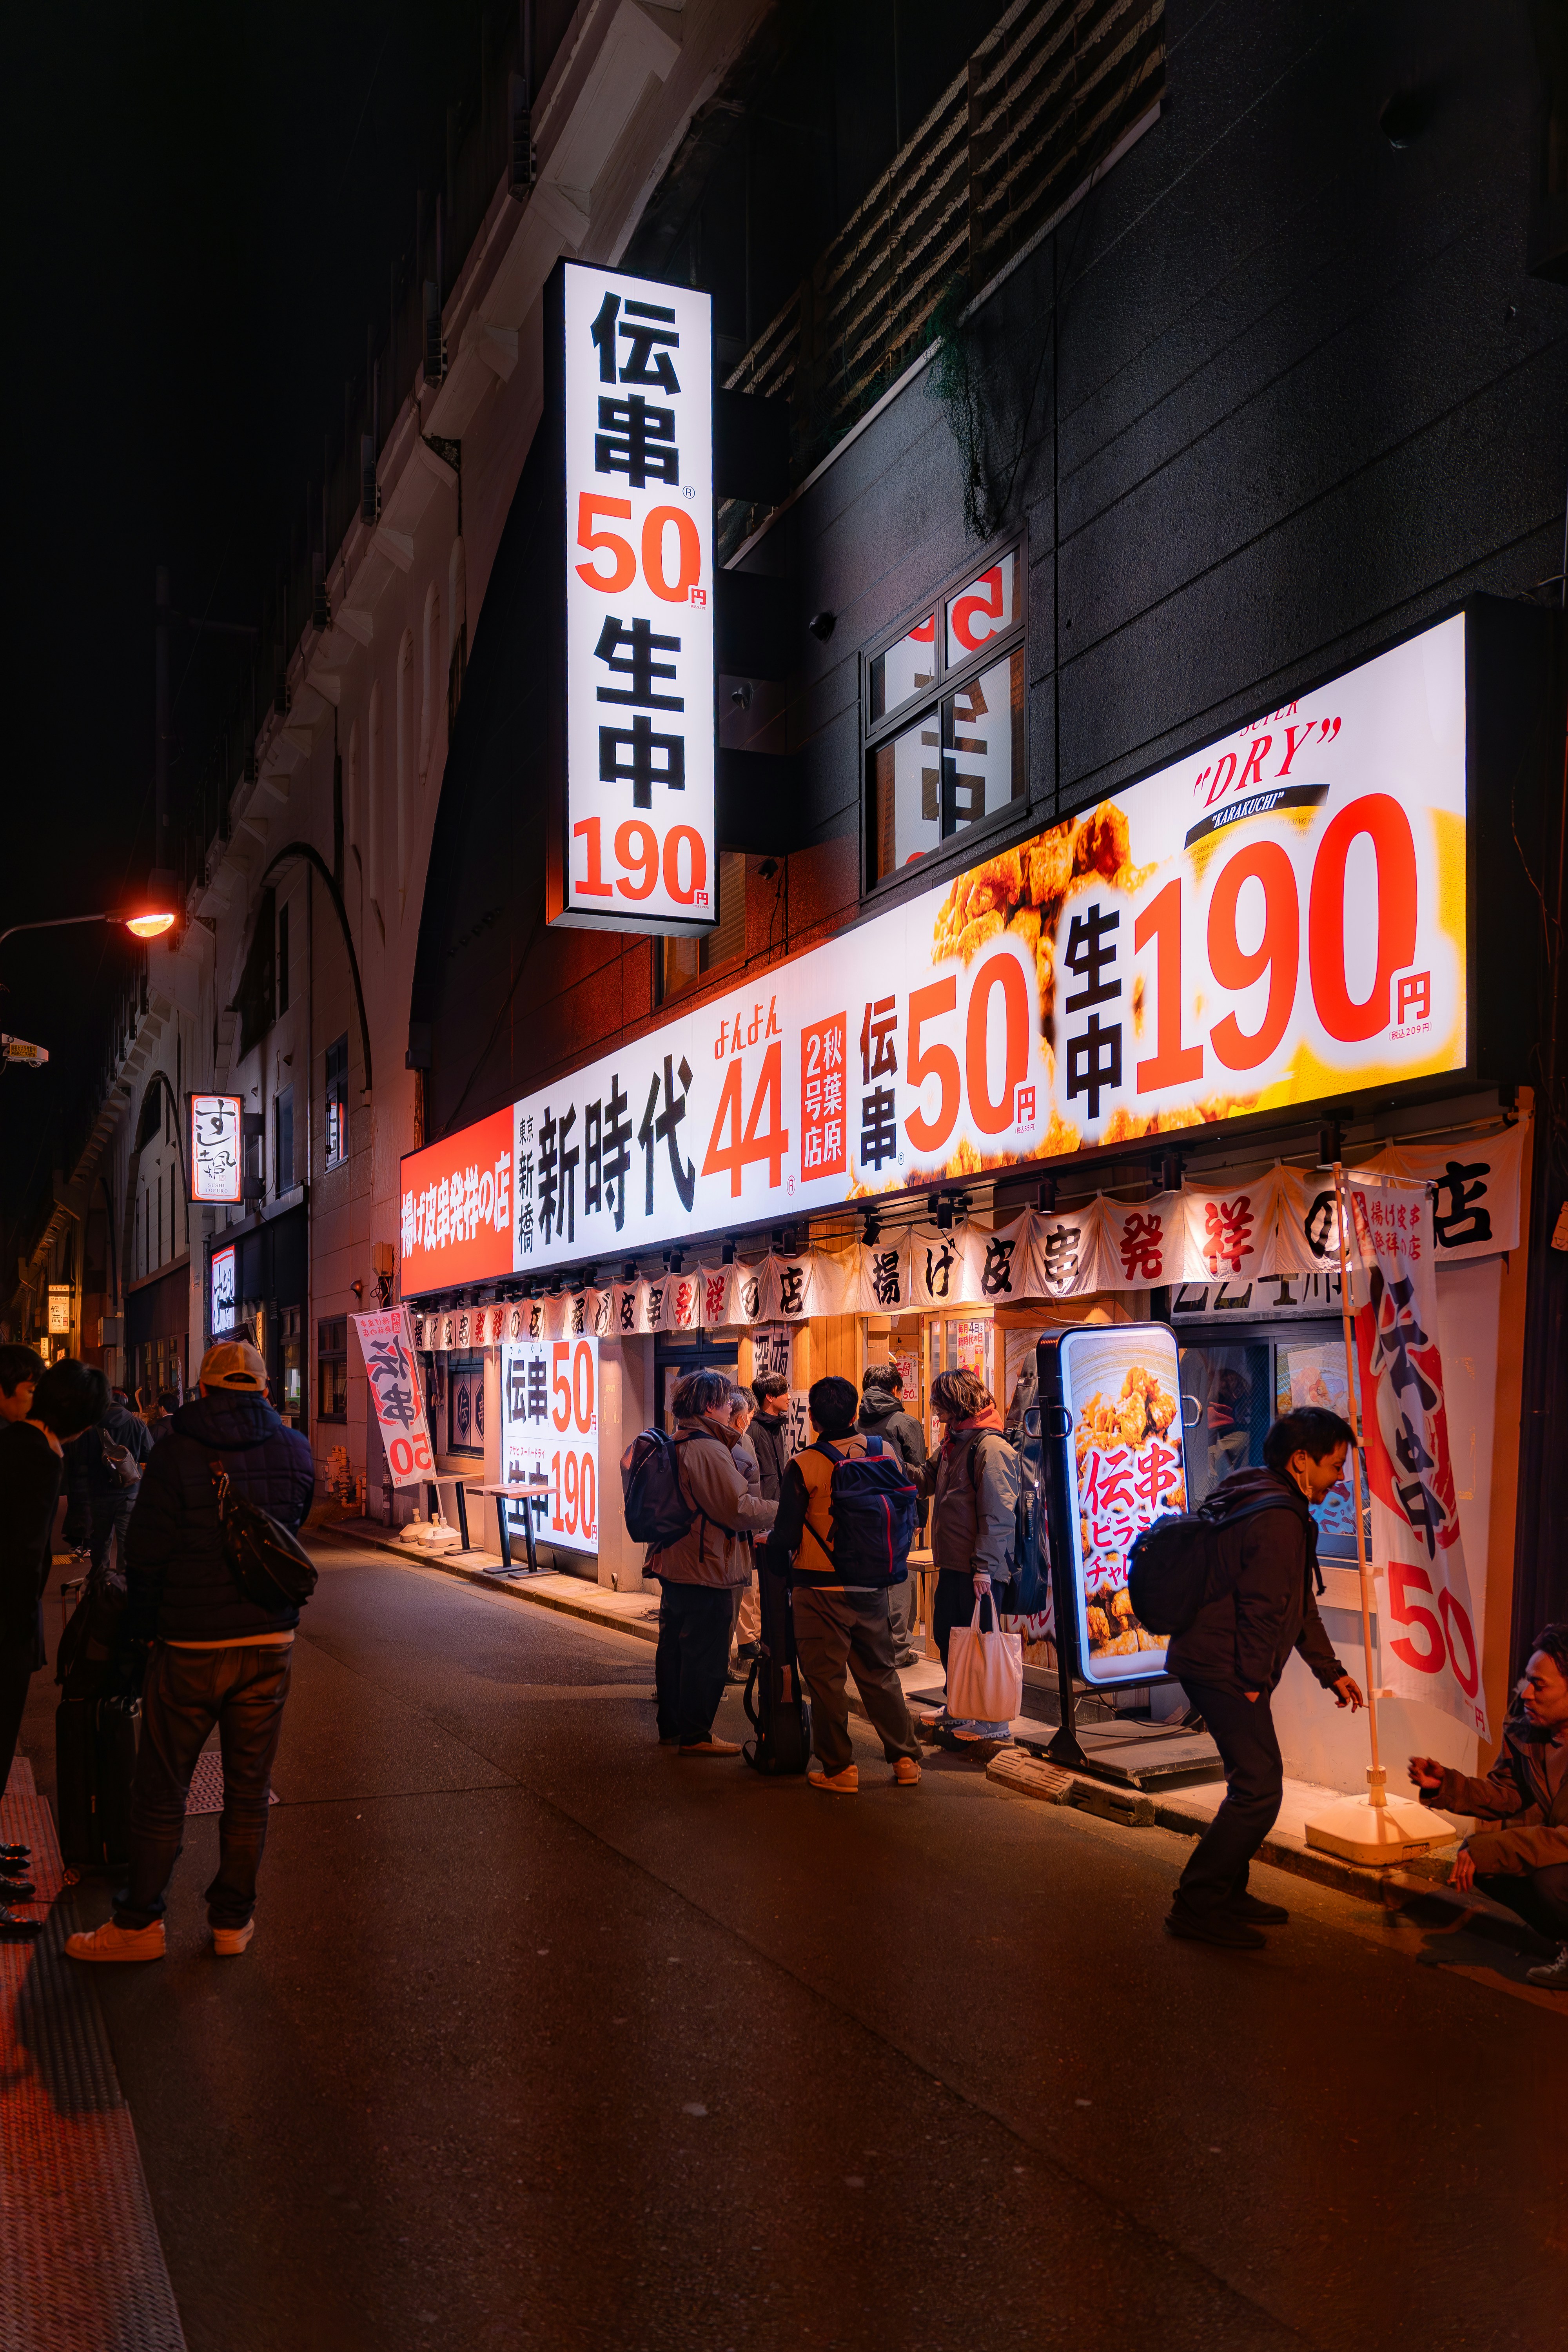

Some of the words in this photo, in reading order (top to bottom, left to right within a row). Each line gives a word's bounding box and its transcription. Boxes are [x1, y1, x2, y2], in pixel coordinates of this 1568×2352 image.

[590, 291, 681, 489] 伝串
[575, 492, 706, 605] 50円
[593, 615, 685, 809] 生中
[574, 817, 709, 905] 190円
[1134, 793, 1430, 1095] 190円
[715, 995, 782, 1060] よんよん
[904, 953, 1035, 1152] 50円
[1064, 903, 1122, 1120] 生中
[1389, 1022, 1432, 1041] (税込209円)
[195, 1099, 239, 1146] すし
[701, 1040, 789, 1198] 44
[804, 1034, 821, 1169] 2号店
[823, 1026, 842, 1161] 秋葉原
[860, 994, 898, 1171] 伝串
[1015, 1123, 1036, 1134] (税込55円)
[401, 1151, 510, 1259] 揚げ皮串発祥の店
[538, 1053, 695, 1245] 新時代
[506, 1356, 548, 1426] 伝串
[552, 1340, 597, 1434] 50円
[958, 1333, 982, 1347] 新時代の日
[1084, 1443, 1177, 1515] 伝串
